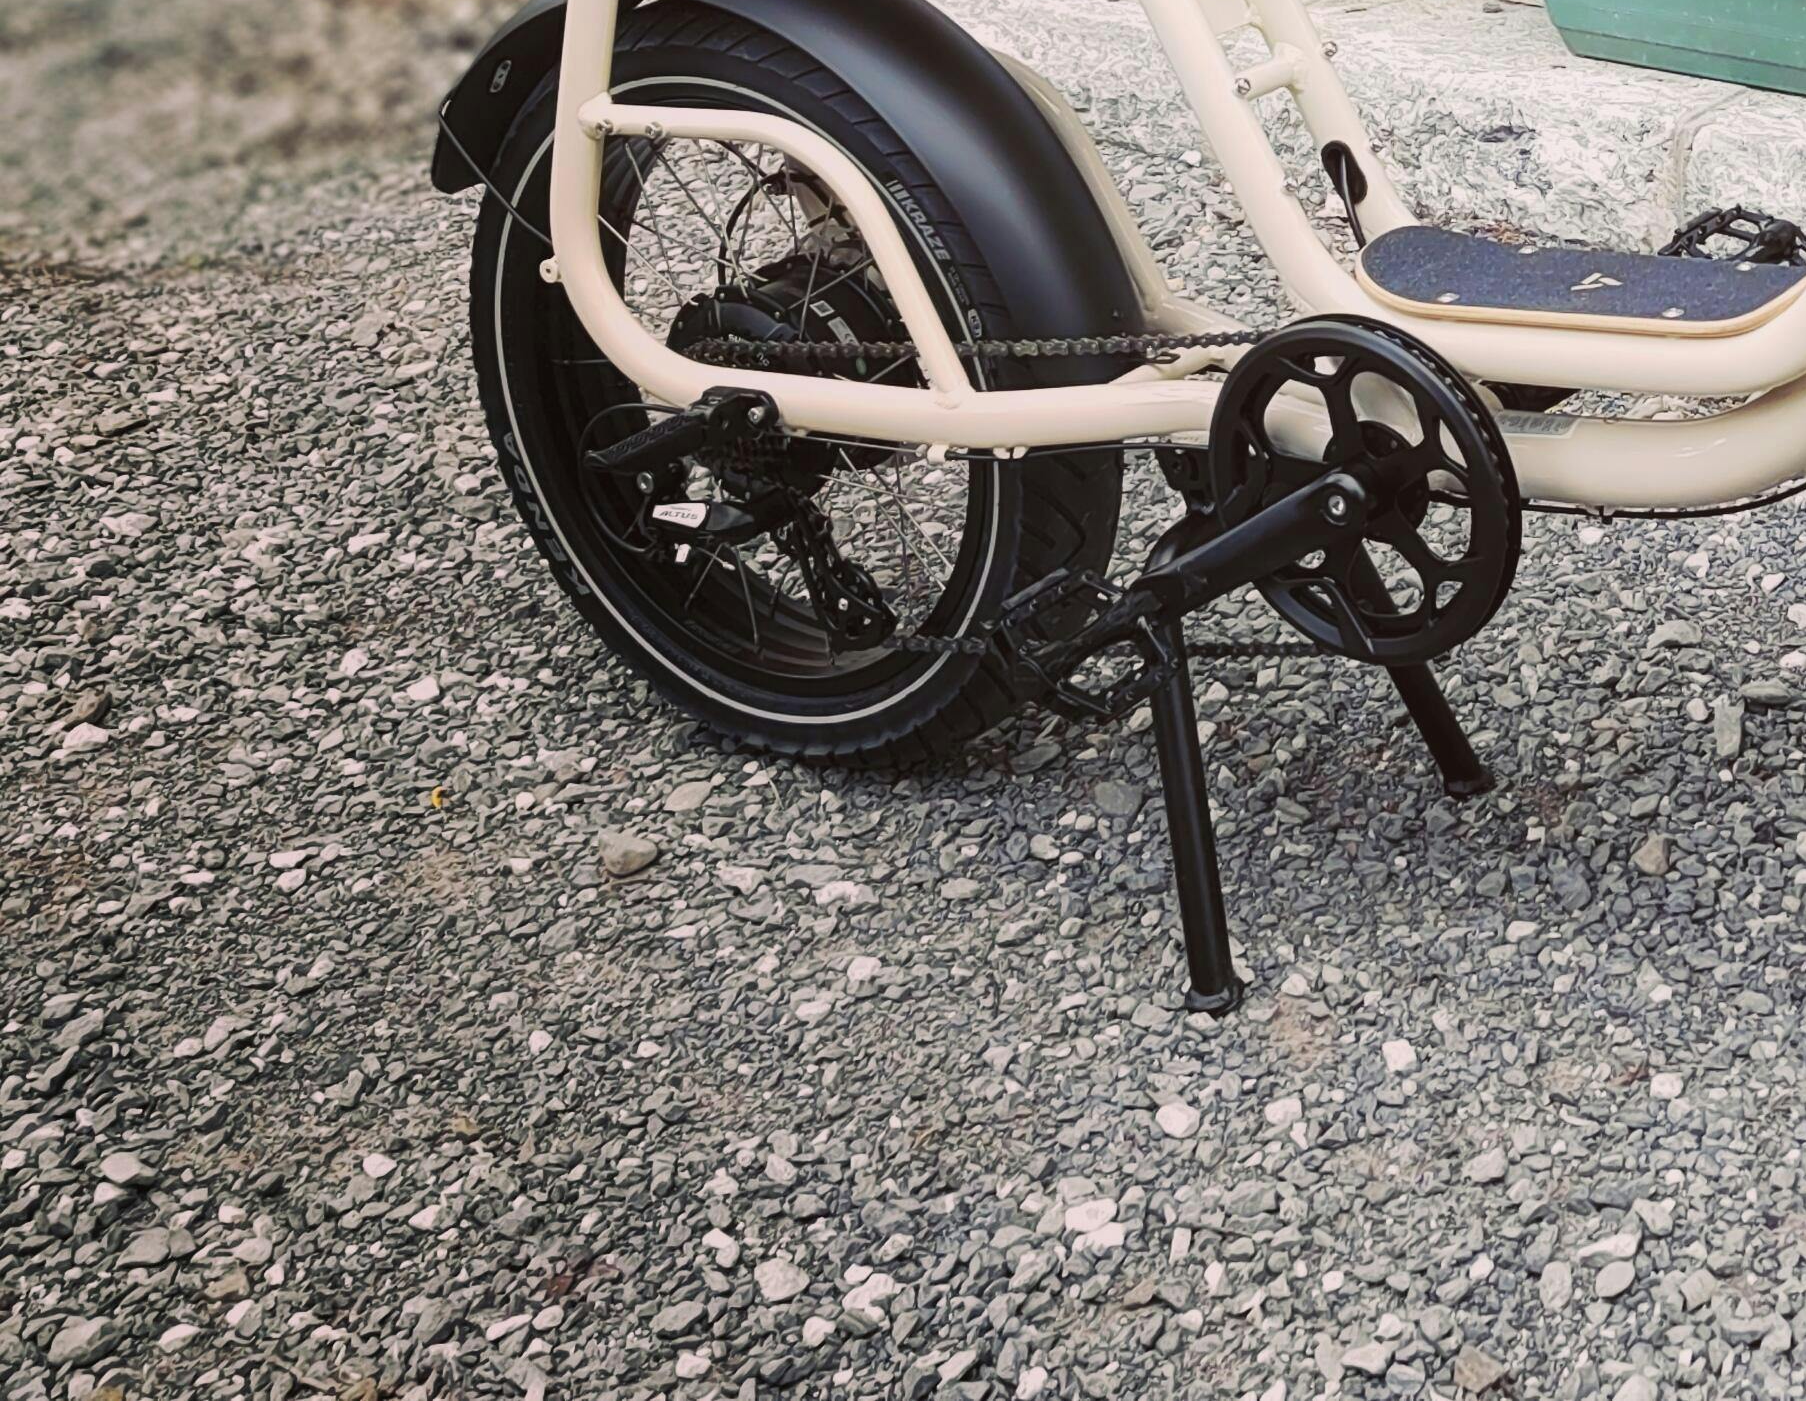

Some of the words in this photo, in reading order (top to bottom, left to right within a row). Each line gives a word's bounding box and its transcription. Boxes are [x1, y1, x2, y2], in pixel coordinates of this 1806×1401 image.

[901, 199, 951, 261] KRAZE
[503, 432, 592, 595] KENDA
[659, 510, 698, 520] ALTUS
